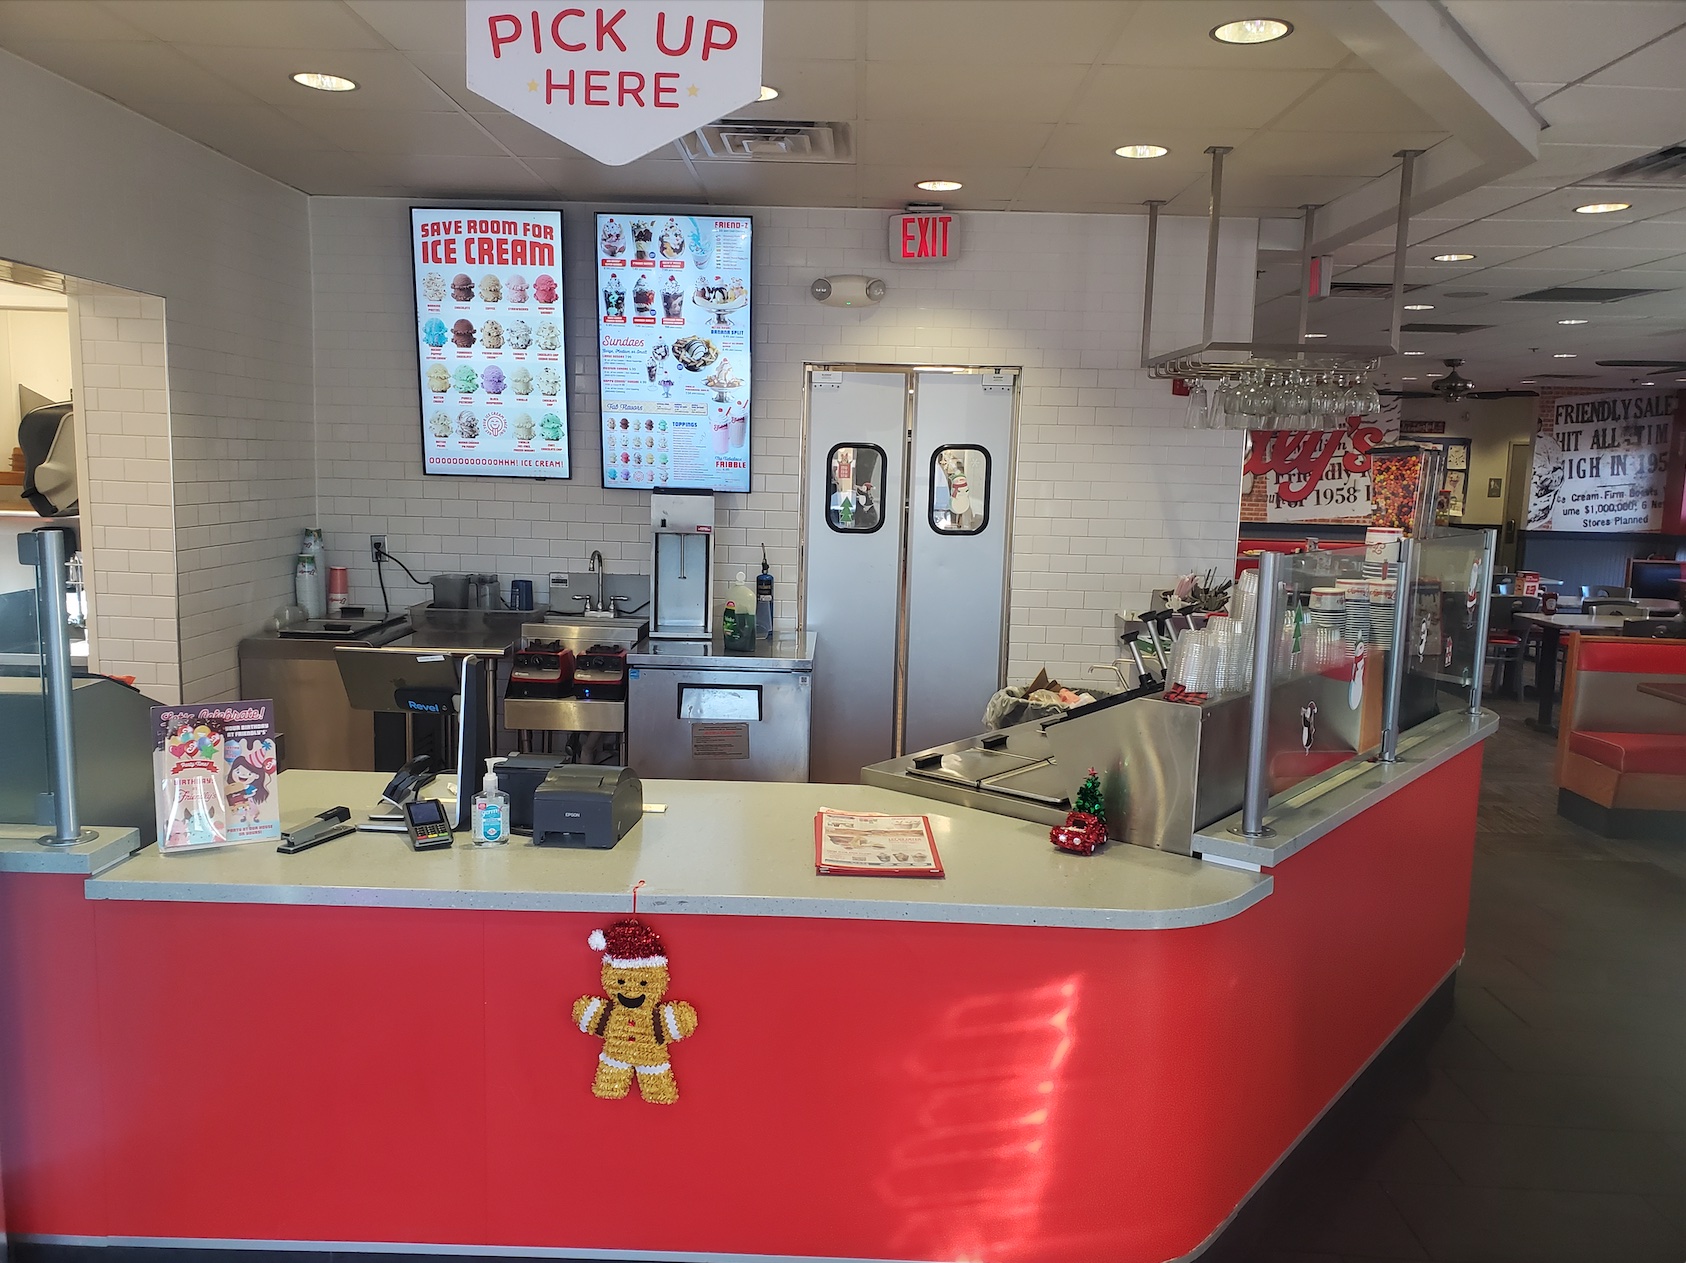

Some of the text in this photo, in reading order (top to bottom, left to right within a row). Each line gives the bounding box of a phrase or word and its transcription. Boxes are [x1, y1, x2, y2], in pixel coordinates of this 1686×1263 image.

[488, 9, 738, 61] PICK UP
[545, 69, 680, 108] HERE
[421, 219, 554, 241] SAVE ROOM FOR
[902, 217, 952, 258] EXIT
[421, 237, 554, 266] ICE CREAM
[602, 335, 645, 347] Sundaes
[1555, 399, 1632, 425] FRIENDLY
[1557, 430, 1582, 452] HIT
[1610, 454, 1627, 476] IN
[1313, 486, 1358, 506] 1958
[1572, 493, 1599, 502] Cream
[1583, 515, 1649, 527] Stores Planned
[408, 700, 439, 712] Revel
